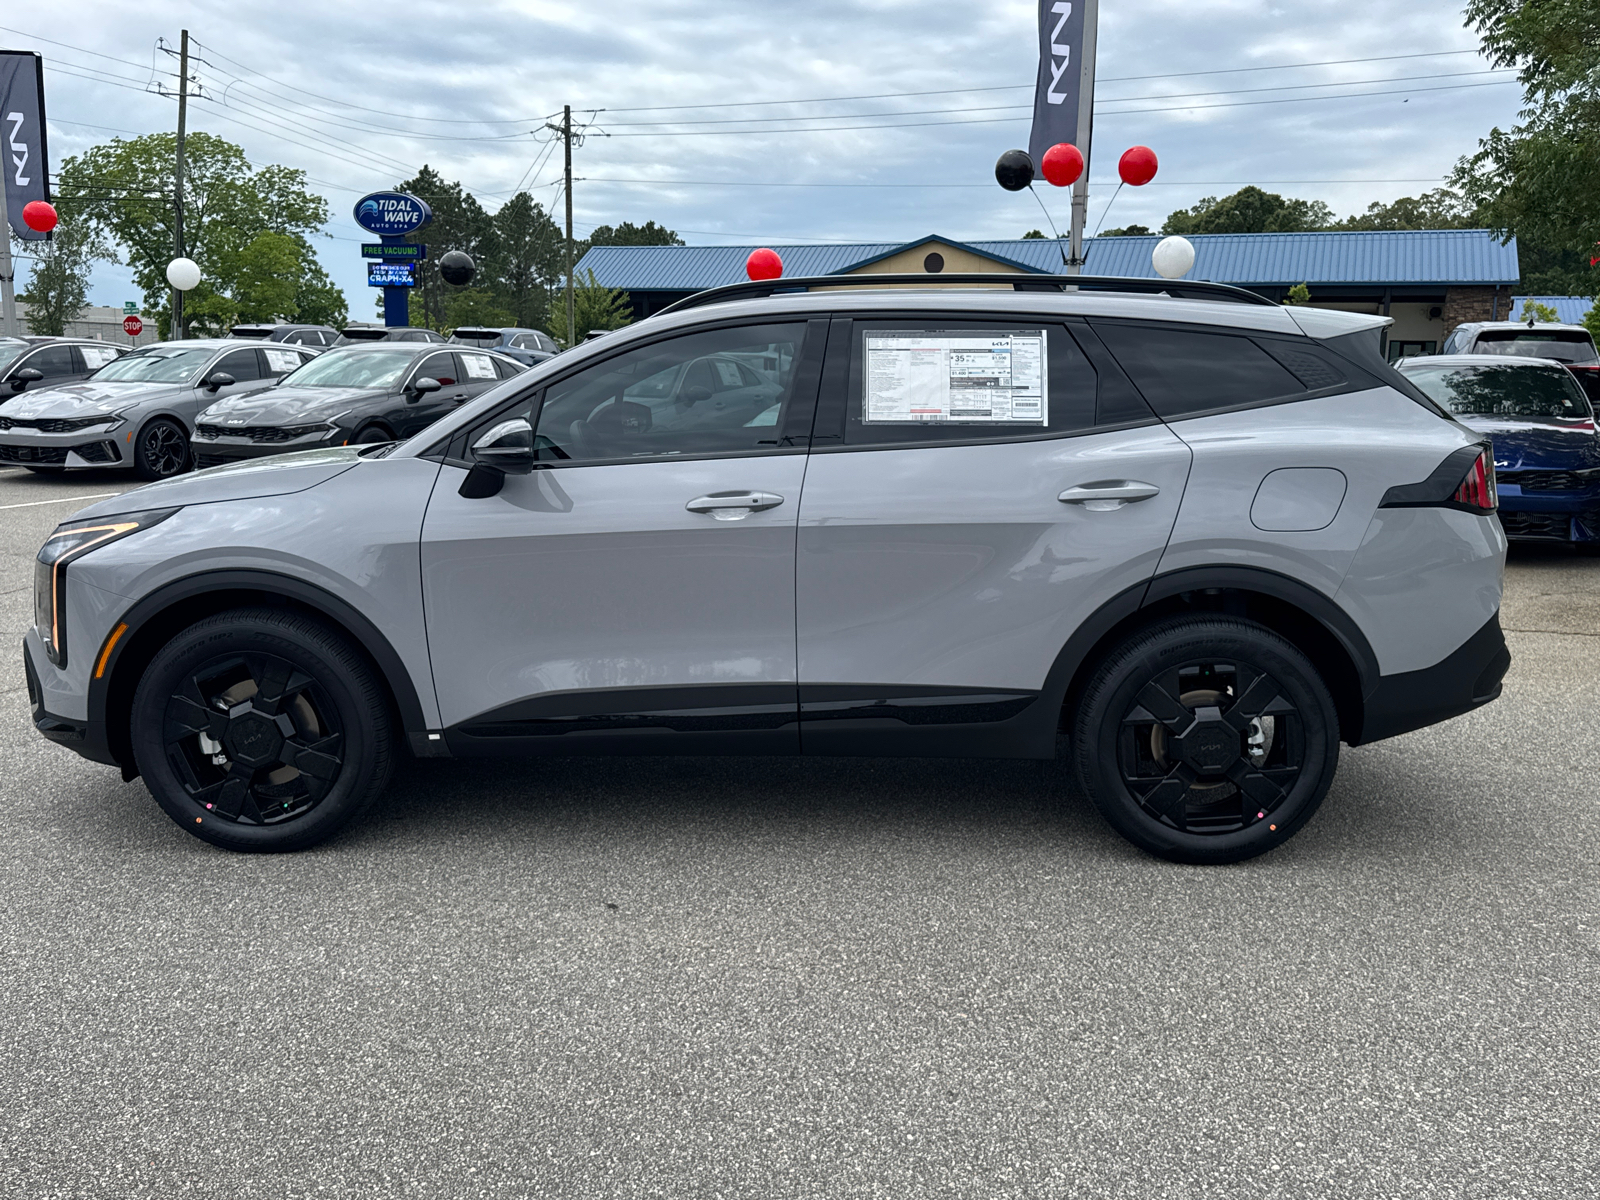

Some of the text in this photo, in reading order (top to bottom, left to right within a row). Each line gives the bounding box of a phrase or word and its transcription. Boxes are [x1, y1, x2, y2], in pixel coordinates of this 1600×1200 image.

[379, 200, 411, 210] TIDAL
[384, 212, 418, 222] WAVE
[124, 321, 141, 330] STOP
